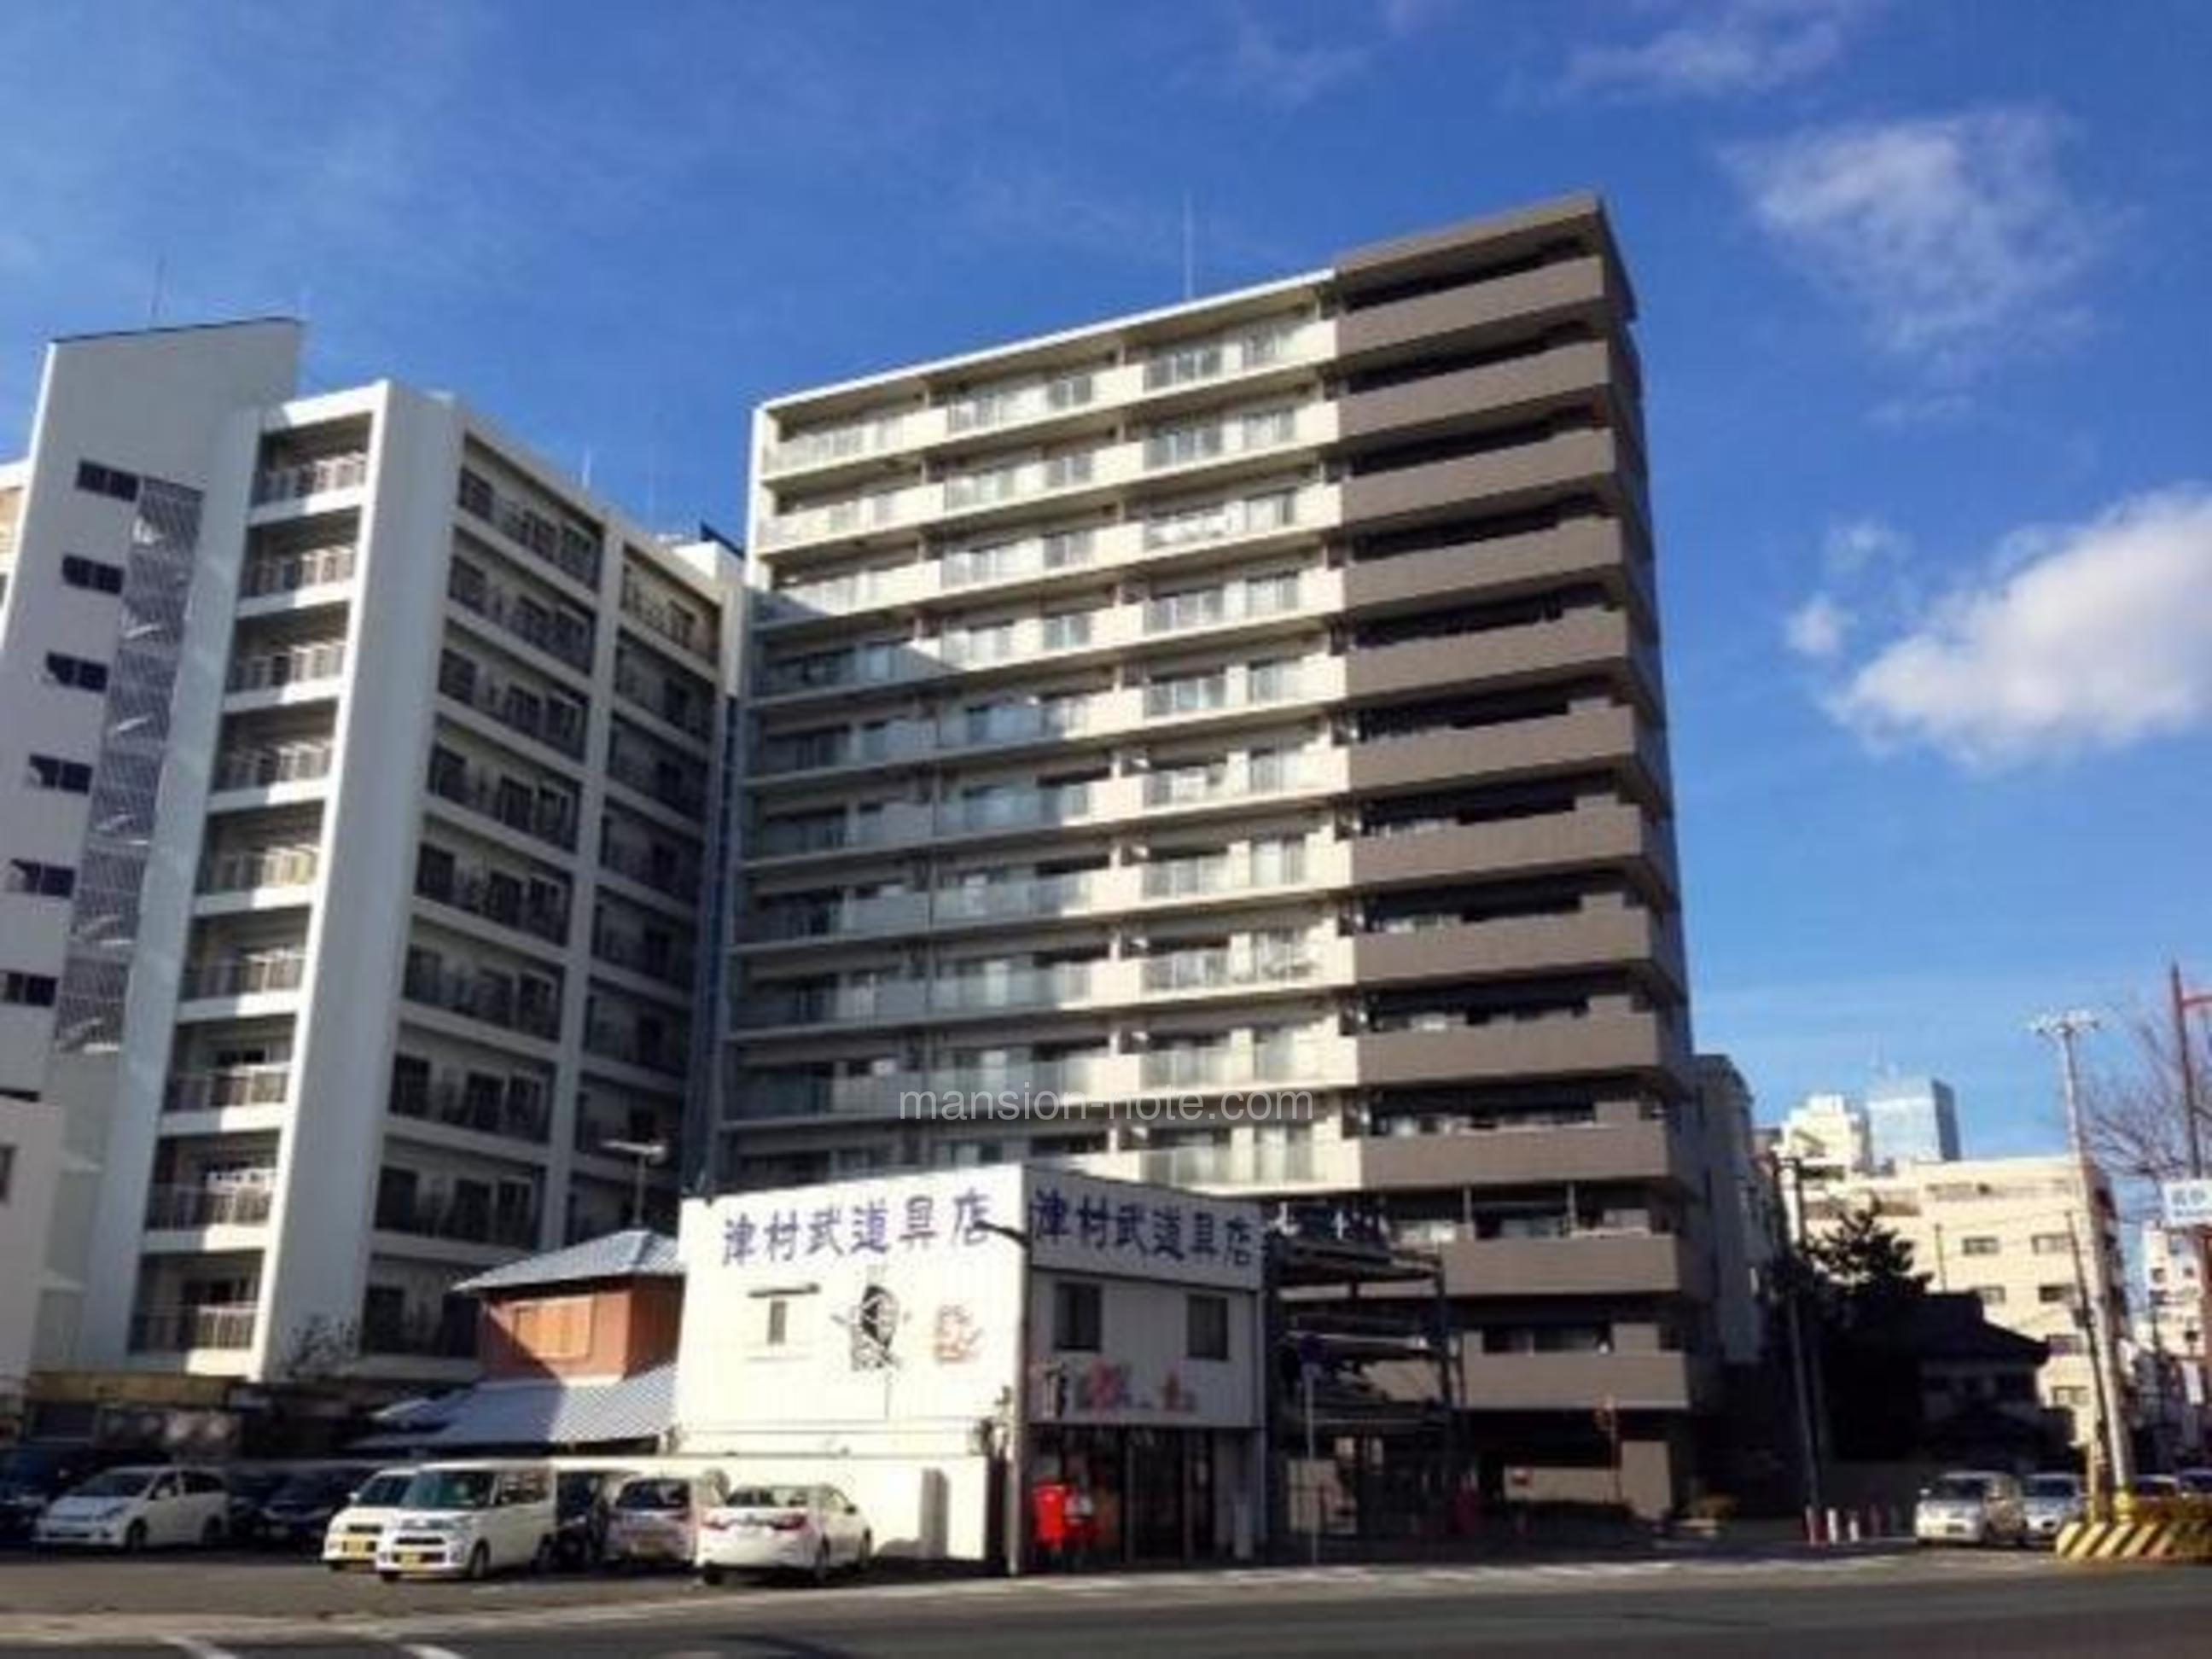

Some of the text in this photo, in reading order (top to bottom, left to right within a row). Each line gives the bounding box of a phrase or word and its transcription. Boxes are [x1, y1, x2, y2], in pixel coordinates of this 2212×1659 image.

[722, 1185, 992, 1267] 津村武道具店
[1031, 1186, 1253, 1267] 津村武道具店
